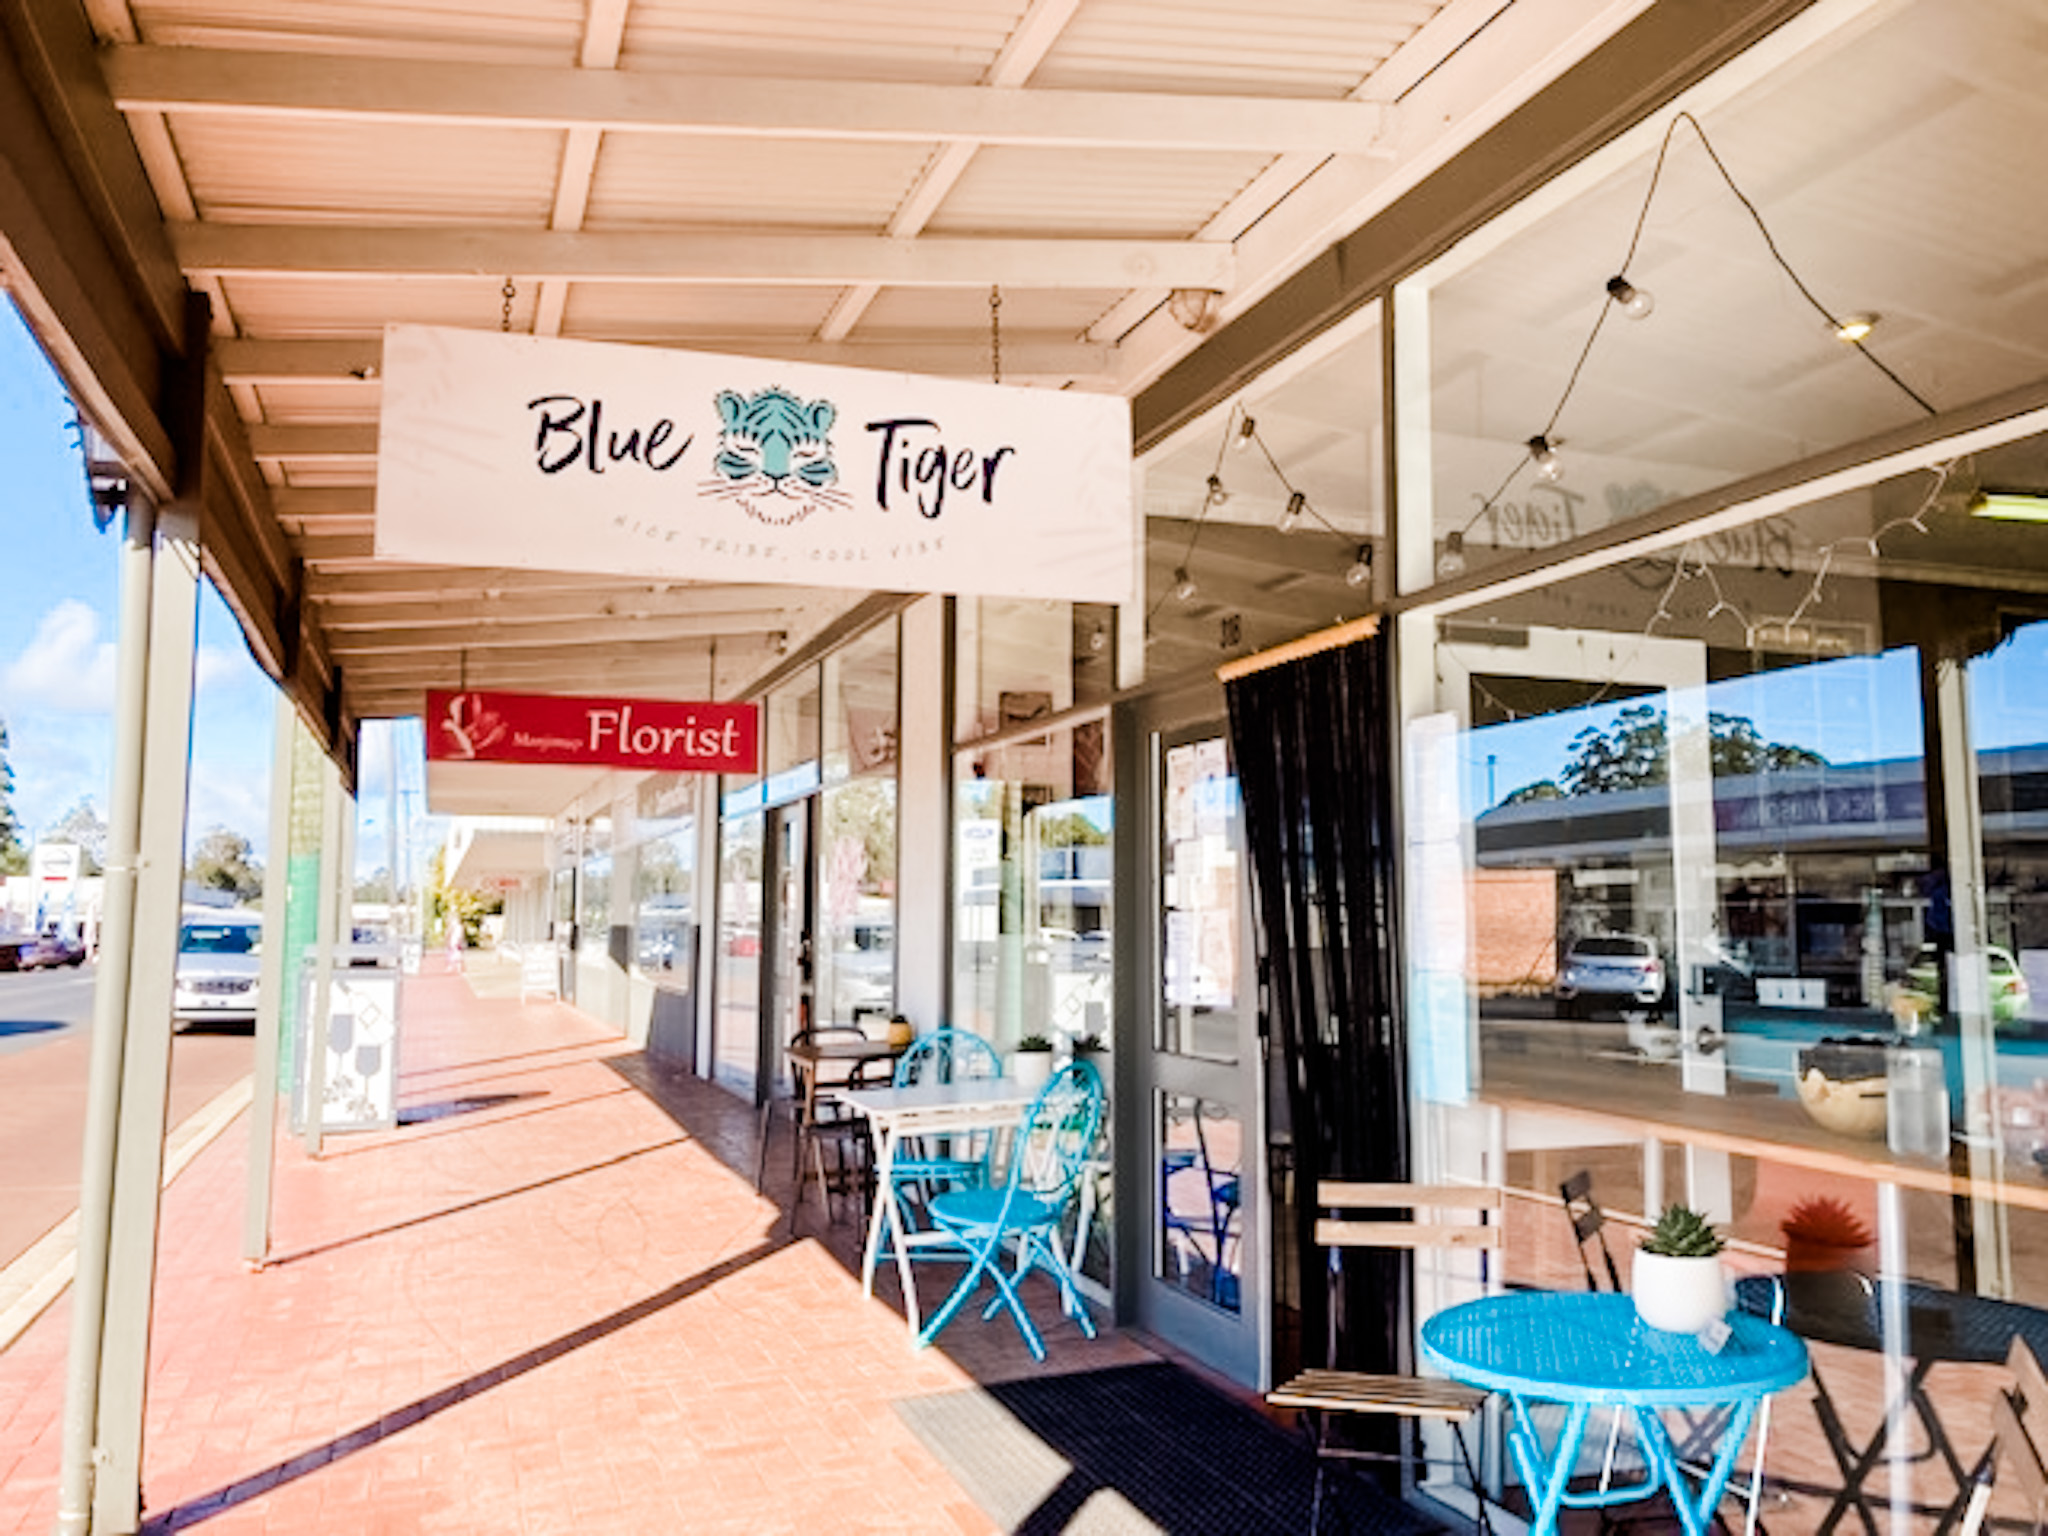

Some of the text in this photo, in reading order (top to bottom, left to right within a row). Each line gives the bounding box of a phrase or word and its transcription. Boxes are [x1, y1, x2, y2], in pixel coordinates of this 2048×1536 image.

[528, 393, 1016, 518] Blue Tiger
[585, 704, 740, 758] Florist
